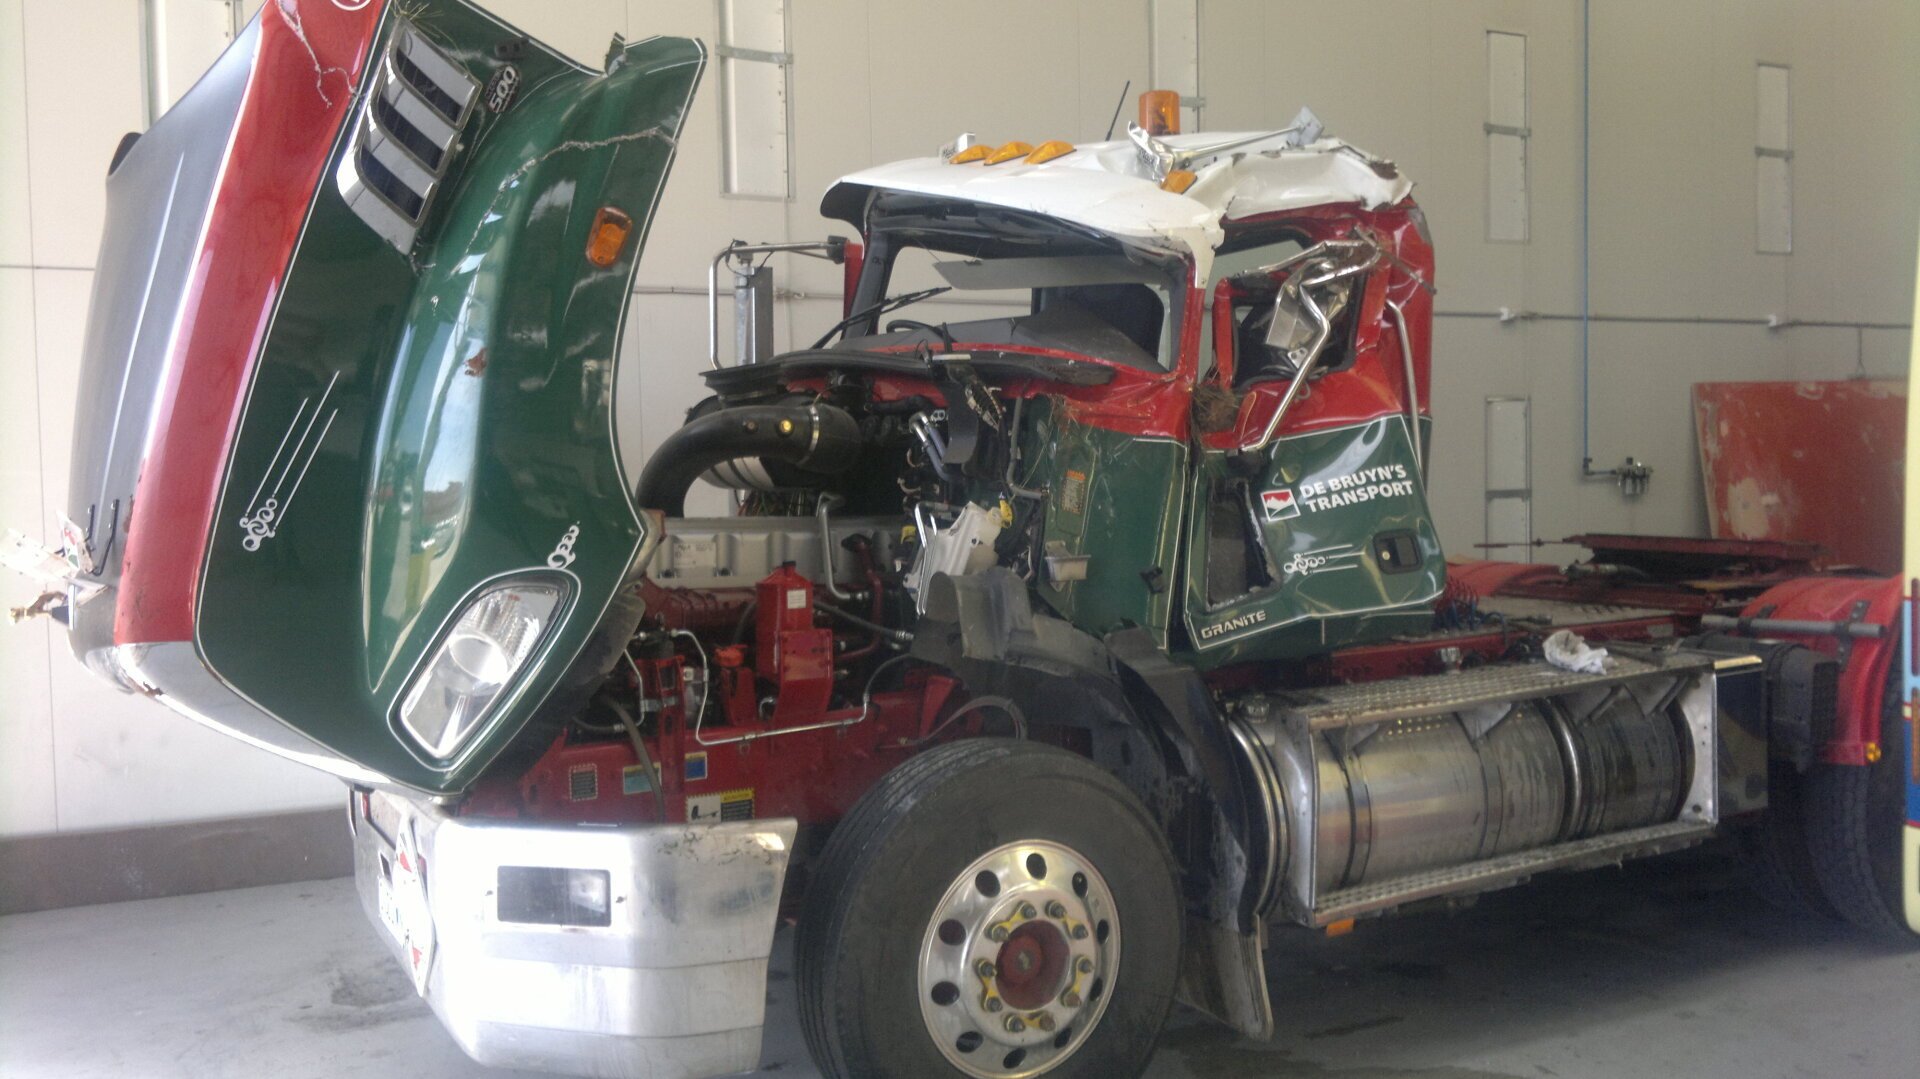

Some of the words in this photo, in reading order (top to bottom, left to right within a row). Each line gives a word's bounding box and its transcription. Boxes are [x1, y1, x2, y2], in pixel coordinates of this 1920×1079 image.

[488, 65, 516, 114] 500
[1300, 481, 1327, 498] DE
[1328, 465, 1407, 492] BRUYN'S
[1305, 481, 1413, 513] TRANSPORT
